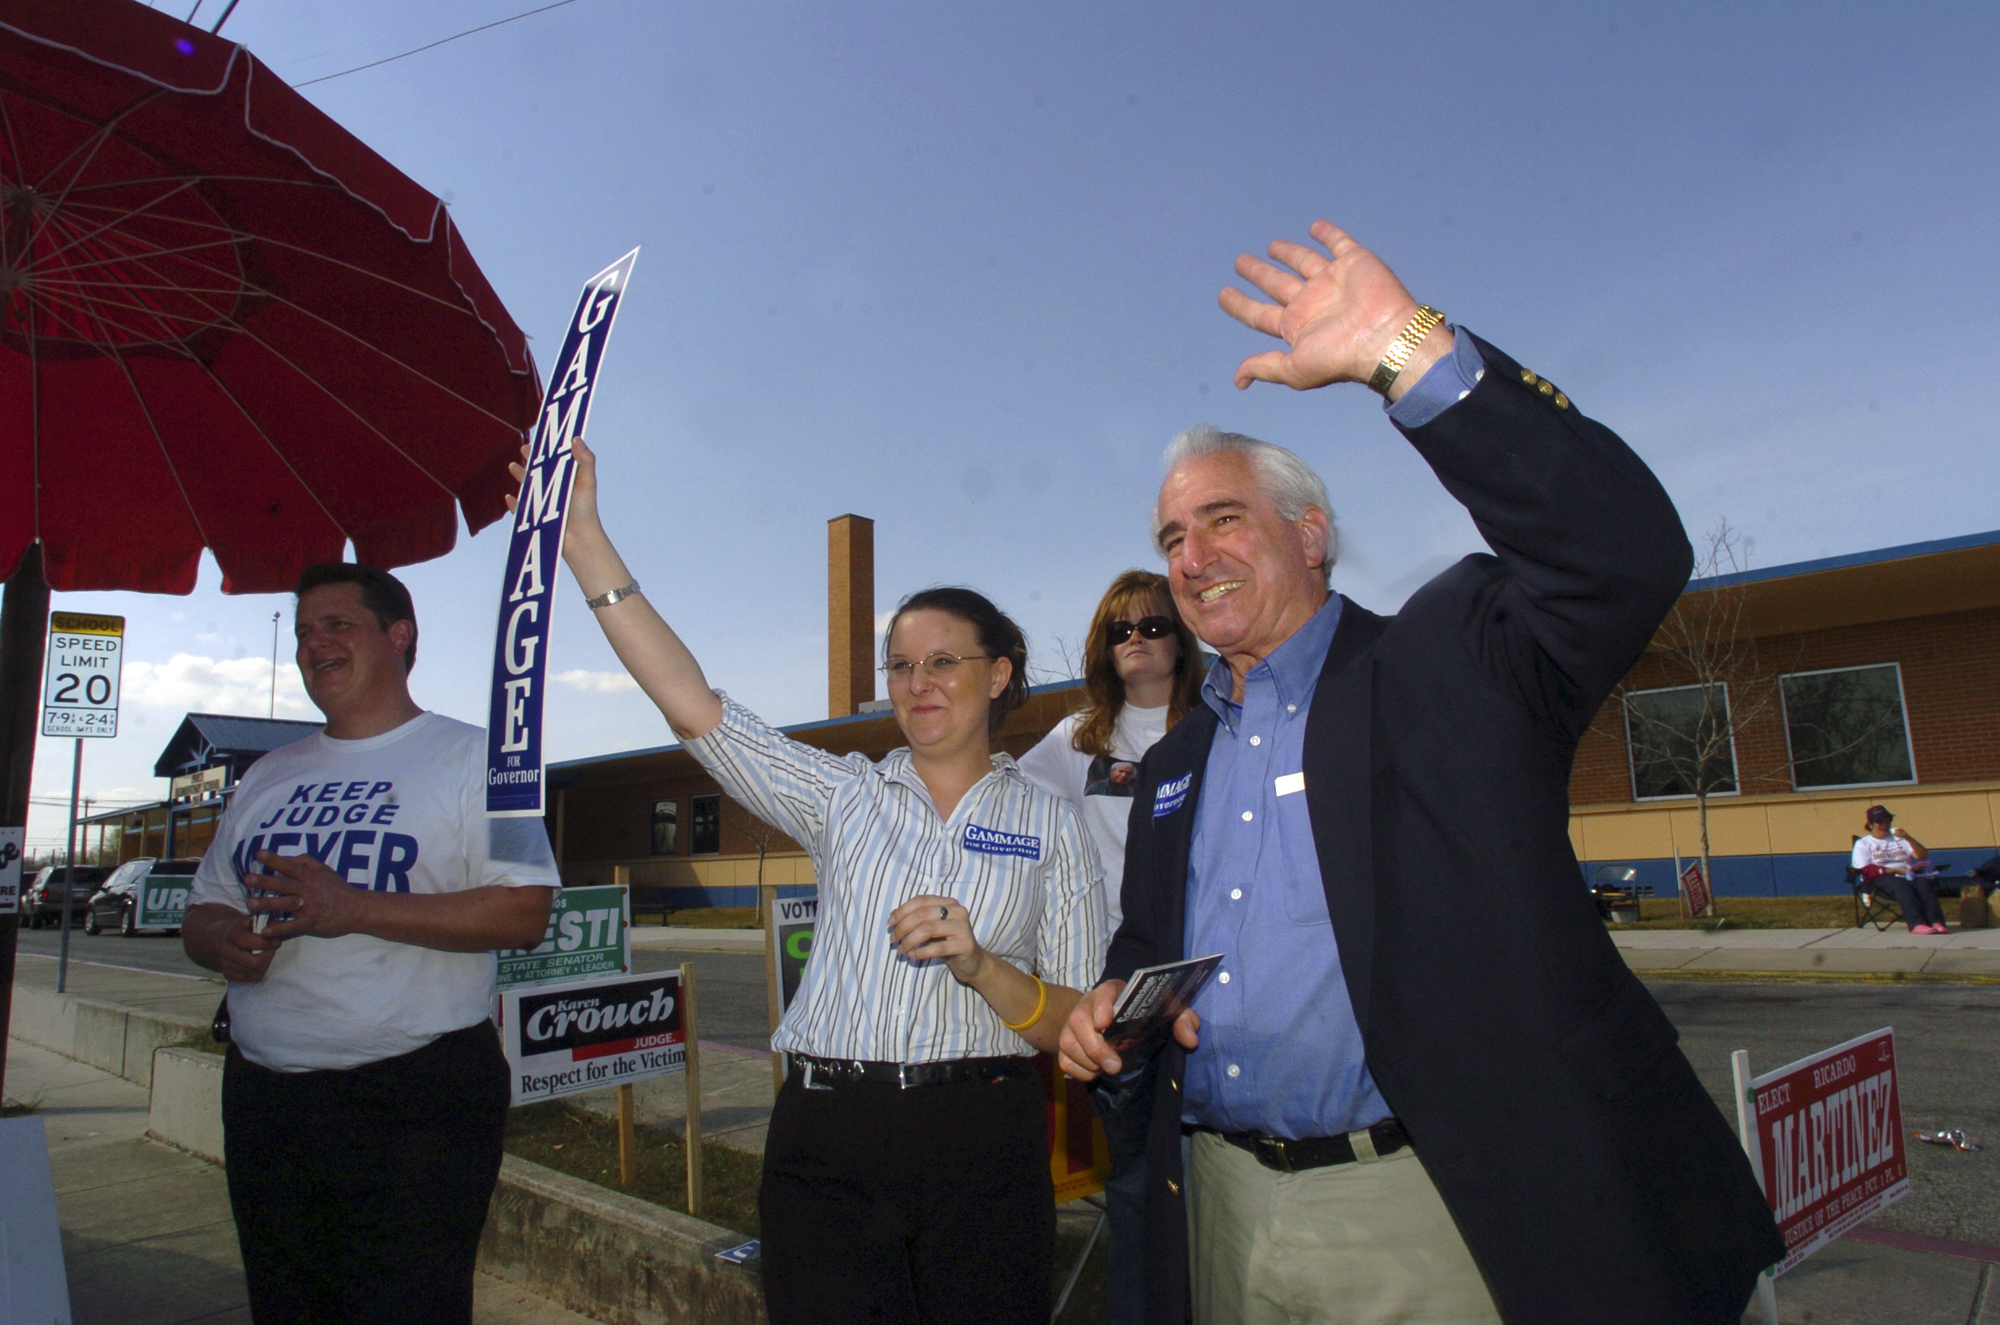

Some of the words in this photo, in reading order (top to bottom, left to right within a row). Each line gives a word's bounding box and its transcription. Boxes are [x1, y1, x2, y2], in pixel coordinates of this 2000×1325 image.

[501, 269, 620, 753] GAMMAGE
[55, 617, 120, 632] SCHOOL
[56, 637, 117, 651] SPEED
[61, 655, 109, 668] LIMIT
[54, 672, 111, 705] 20
[48, 712, 70, 724] 7-9
[85, 713, 108, 725] 2-4
[488, 767, 540, 785] Governor
[287, 781, 393, 805] KEEP
[259, 803, 400, 829] JUDGE
[965, 825, 1039, 848] GAMMAGE
[982, 843, 1038, 856] Governor
[501, 961, 541, 973] STATE
[547, 953, 605, 968] SENATOR
[524, 966, 571, 980] ATTORNEY
[581, 961, 615, 973] LEADER
[526, 988, 675, 1042] Crouch
[556, 998, 600, 1012] Karen
[633, 1032, 676, 1049] JUDGE.
[521, 1067, 582, 1094] Respect
[586, 1061, 608, 1081] for
[613, 1056, 637, 1076] the
[1757, 1082, 1791, 1115] ELECT
[1813, 1054, 1857, 1089] RICARDO
[1772, 1069, 1894, 1225] MARTINEZ
[1814, 1208, 1824, 1227] OF
[1825, 1199, 1840, 1219] THE
